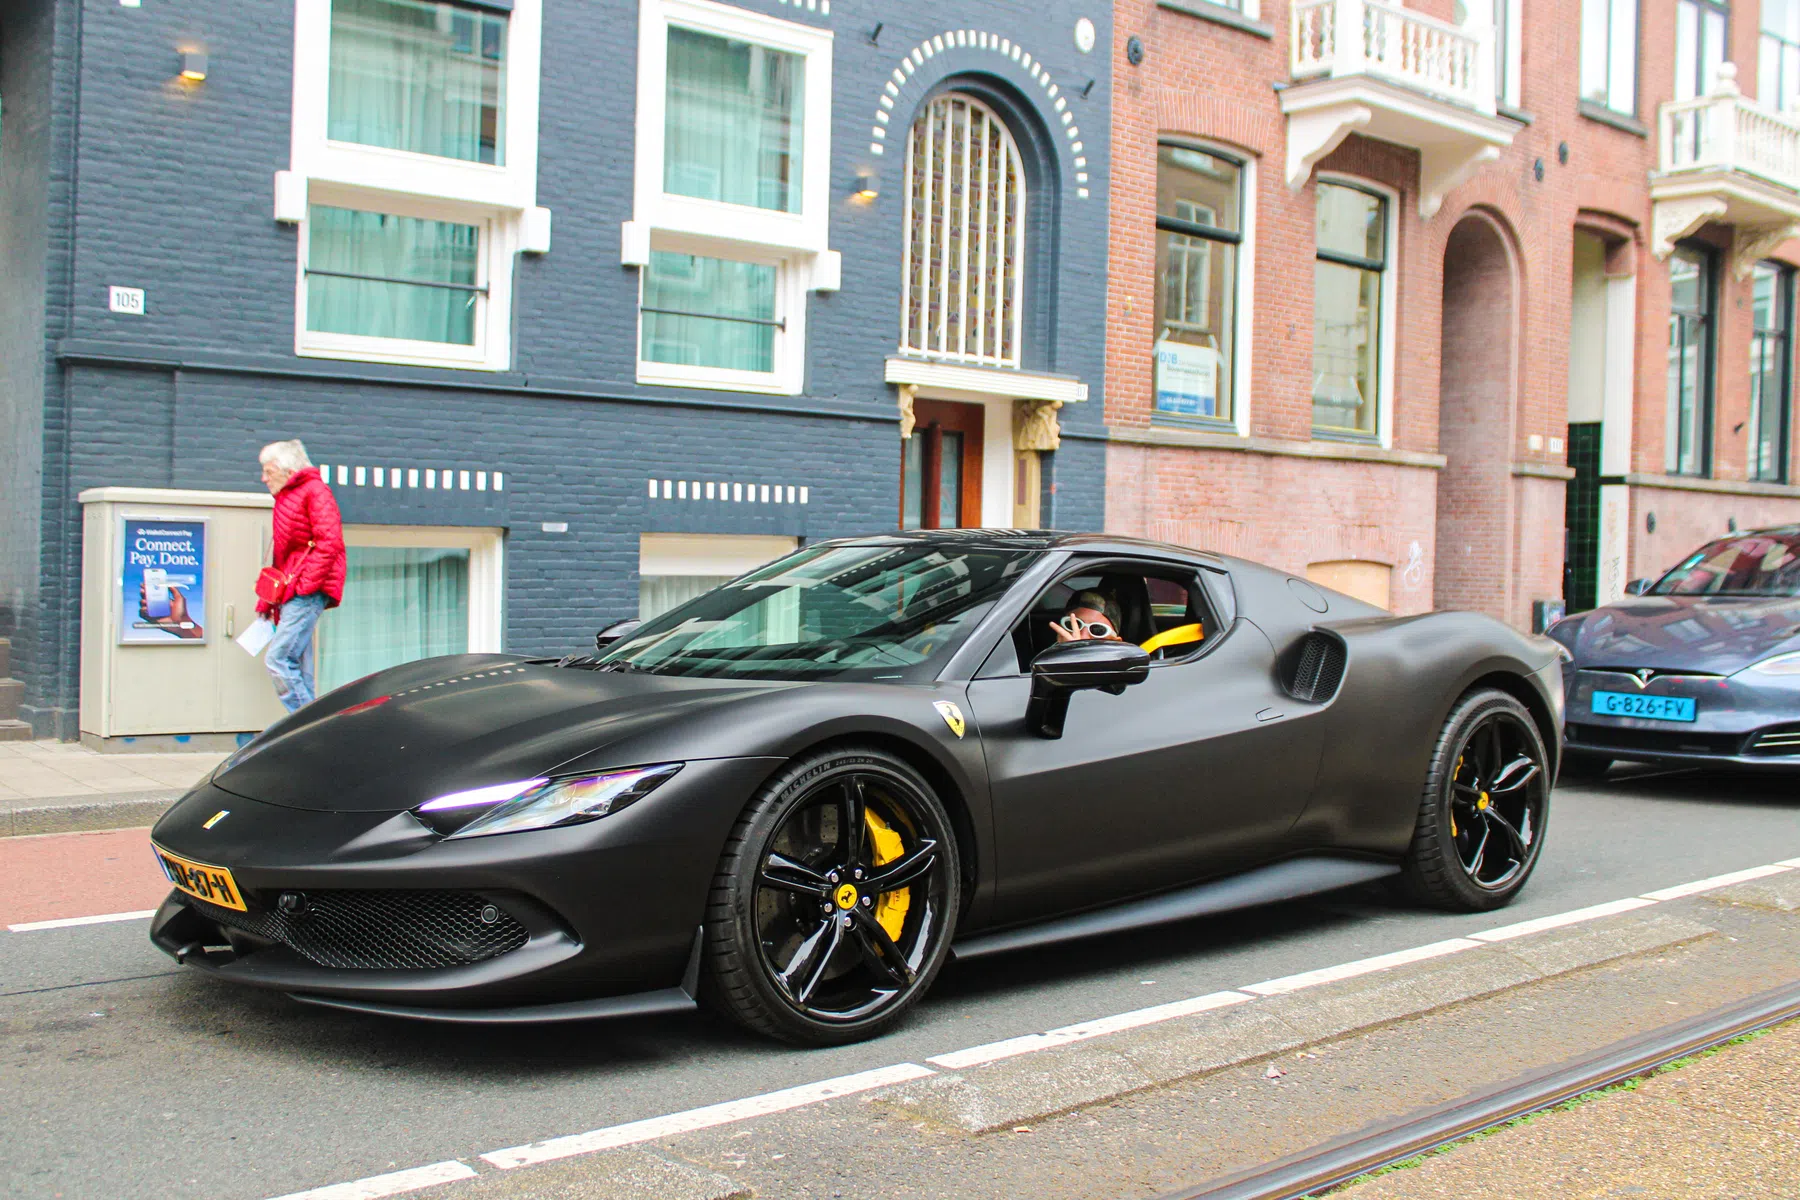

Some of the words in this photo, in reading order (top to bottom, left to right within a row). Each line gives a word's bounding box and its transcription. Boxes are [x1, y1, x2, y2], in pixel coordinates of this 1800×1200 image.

[115, 292, 139, 308] 105
[135, 538, 196, 552] Connect.
[130, 551, 157, 567] Pay.
[160, 552, 199, 565] Done.
[1606, 695, 1685, 716] G-826-FV
[780, 762, 831, 801] MICHELIN
